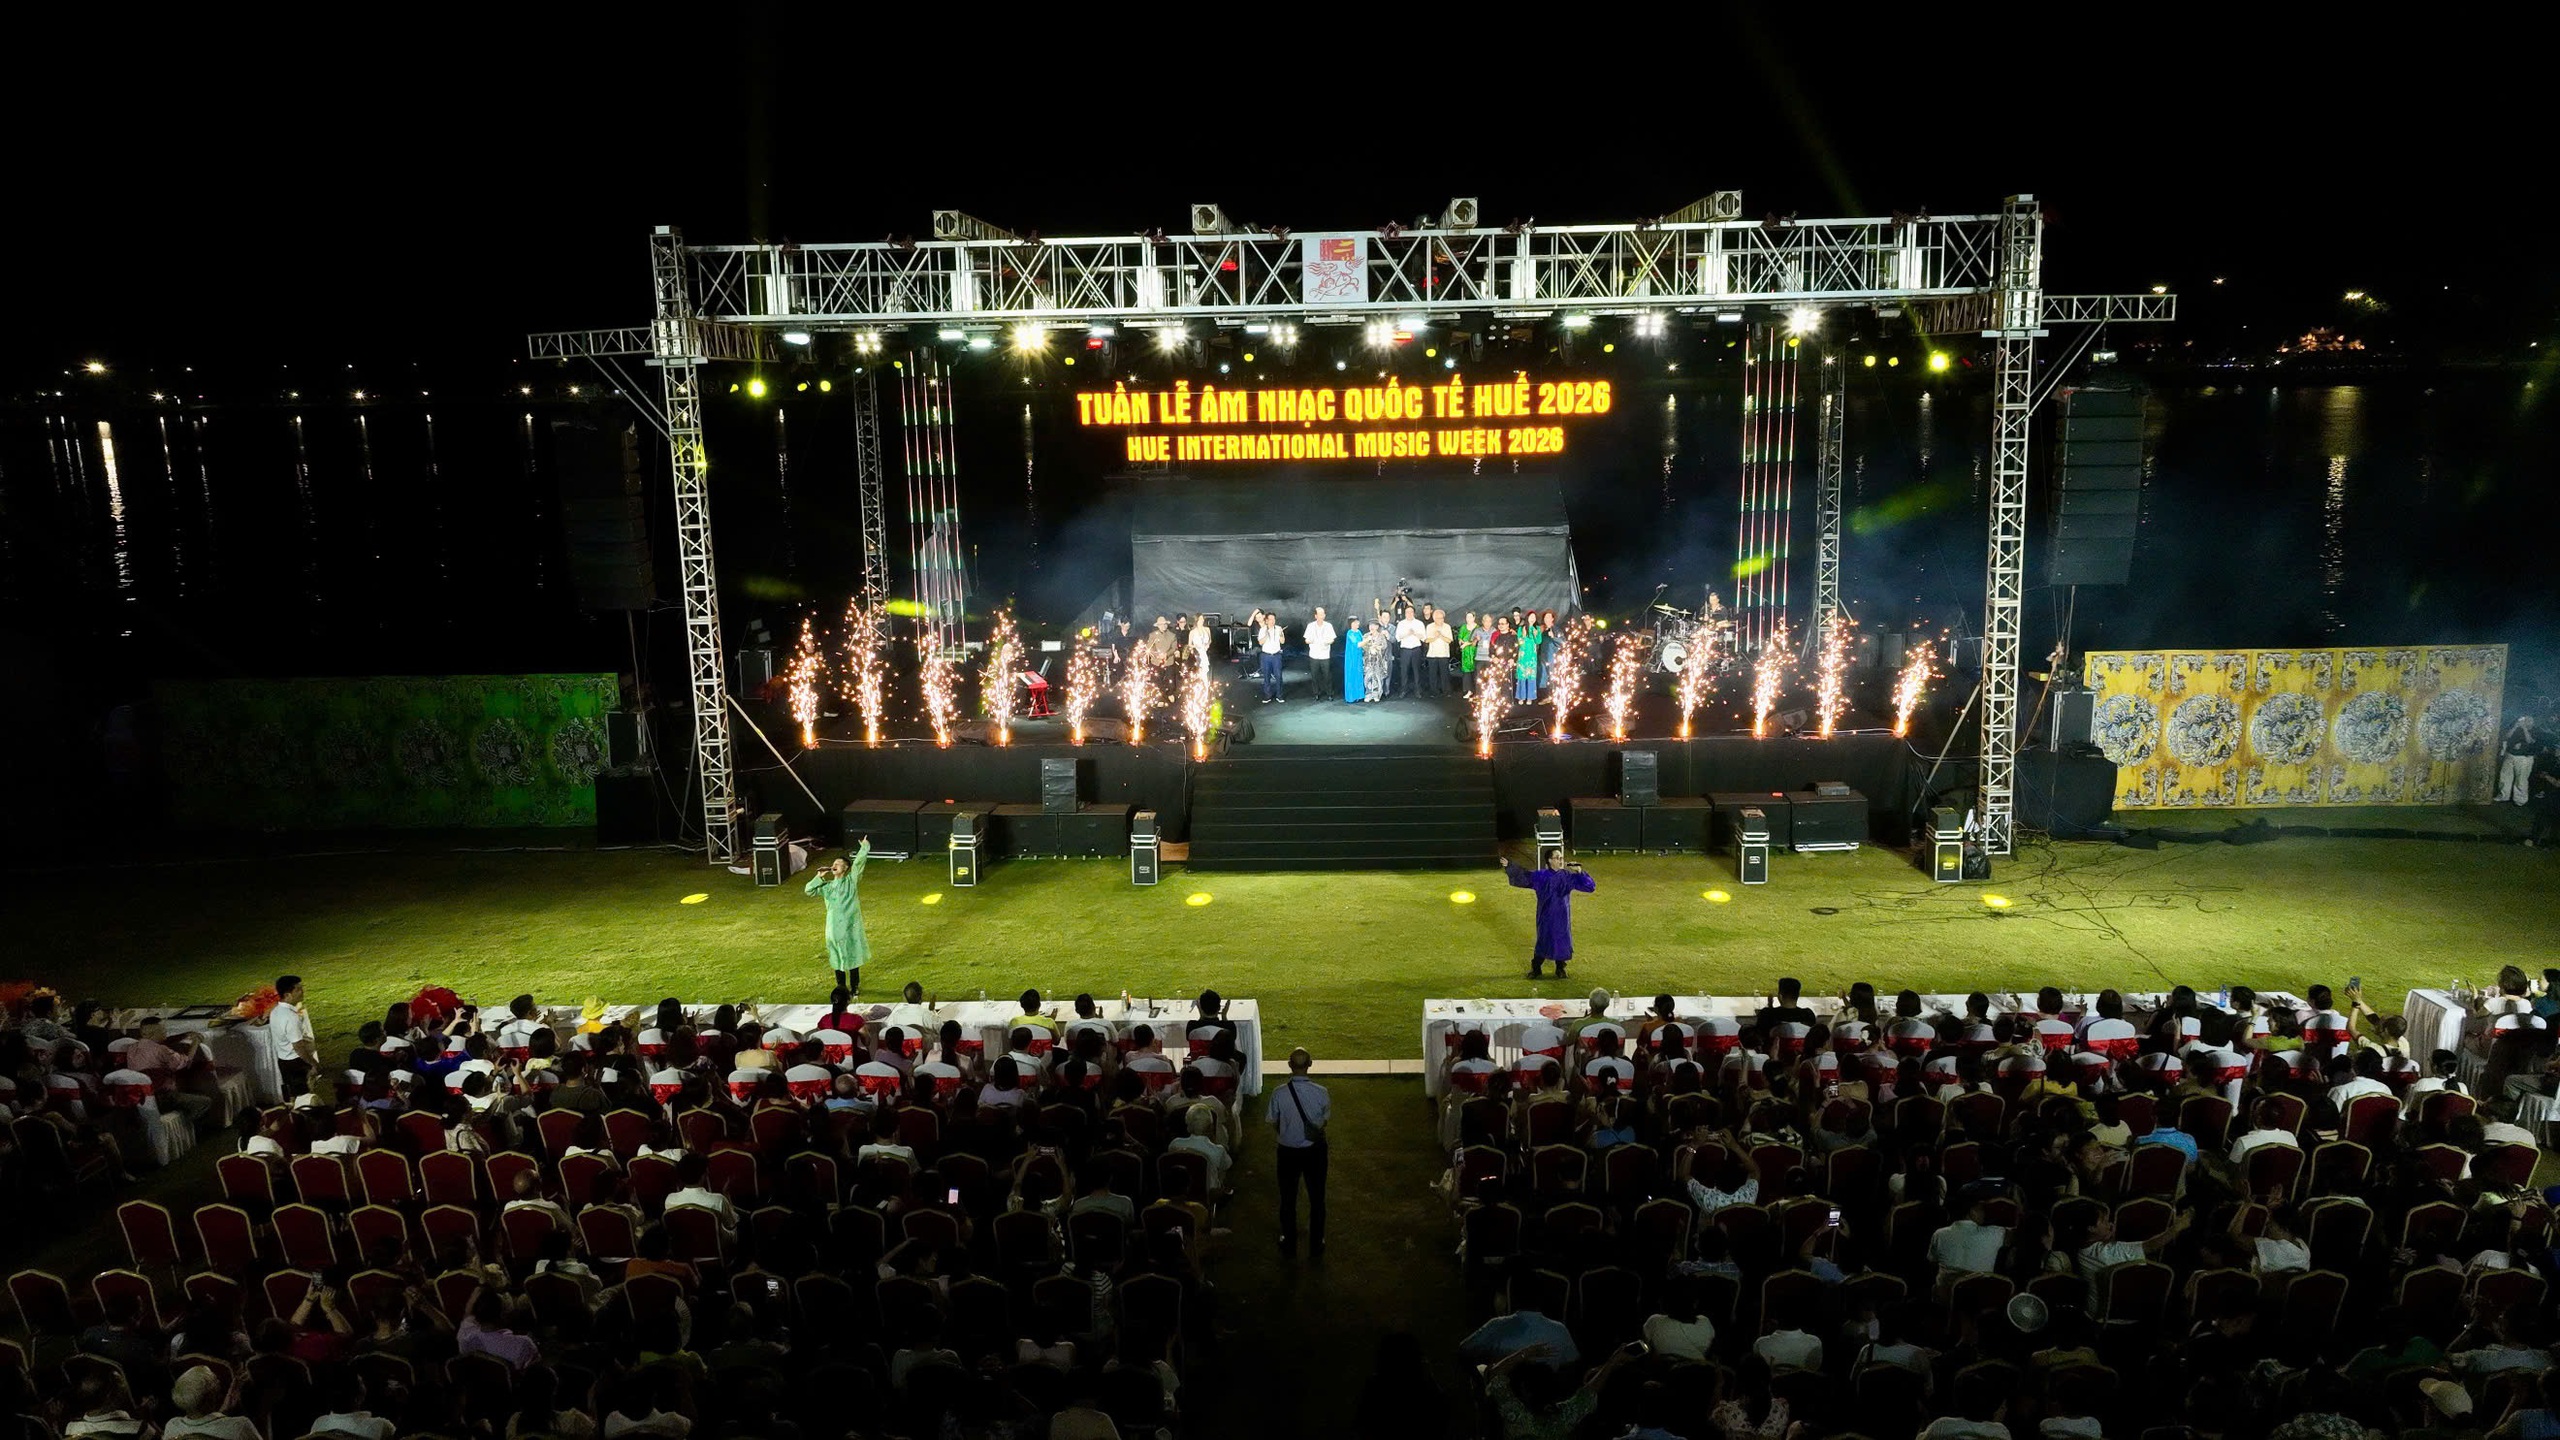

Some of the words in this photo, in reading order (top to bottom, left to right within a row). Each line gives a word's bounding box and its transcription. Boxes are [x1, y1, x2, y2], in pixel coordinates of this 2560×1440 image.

[1077, 380, 1150, 425] TUẦN
[1159, 379, 1192, 424] LỄ
[1199, 384, 1248, 423] ÂM
[1257, 388, 1336, 428] NHẠC
[1344, 375, 1424, 422] QUỐC
[1432, 373, 1465, 418] TẾ
[1472, 371, 1531, 417] HUẾ
[1538, 380, 1611, 415] 2026
[1127, 435, 1171, 461] HUE
[1177, 432, 1349, 461] INTERNATIONAL
[1354, 430, 1430, 458] MUSIC
[1437, 427, 1502, 456] WEEK
[1508, 426, 1564, 454] 2026
